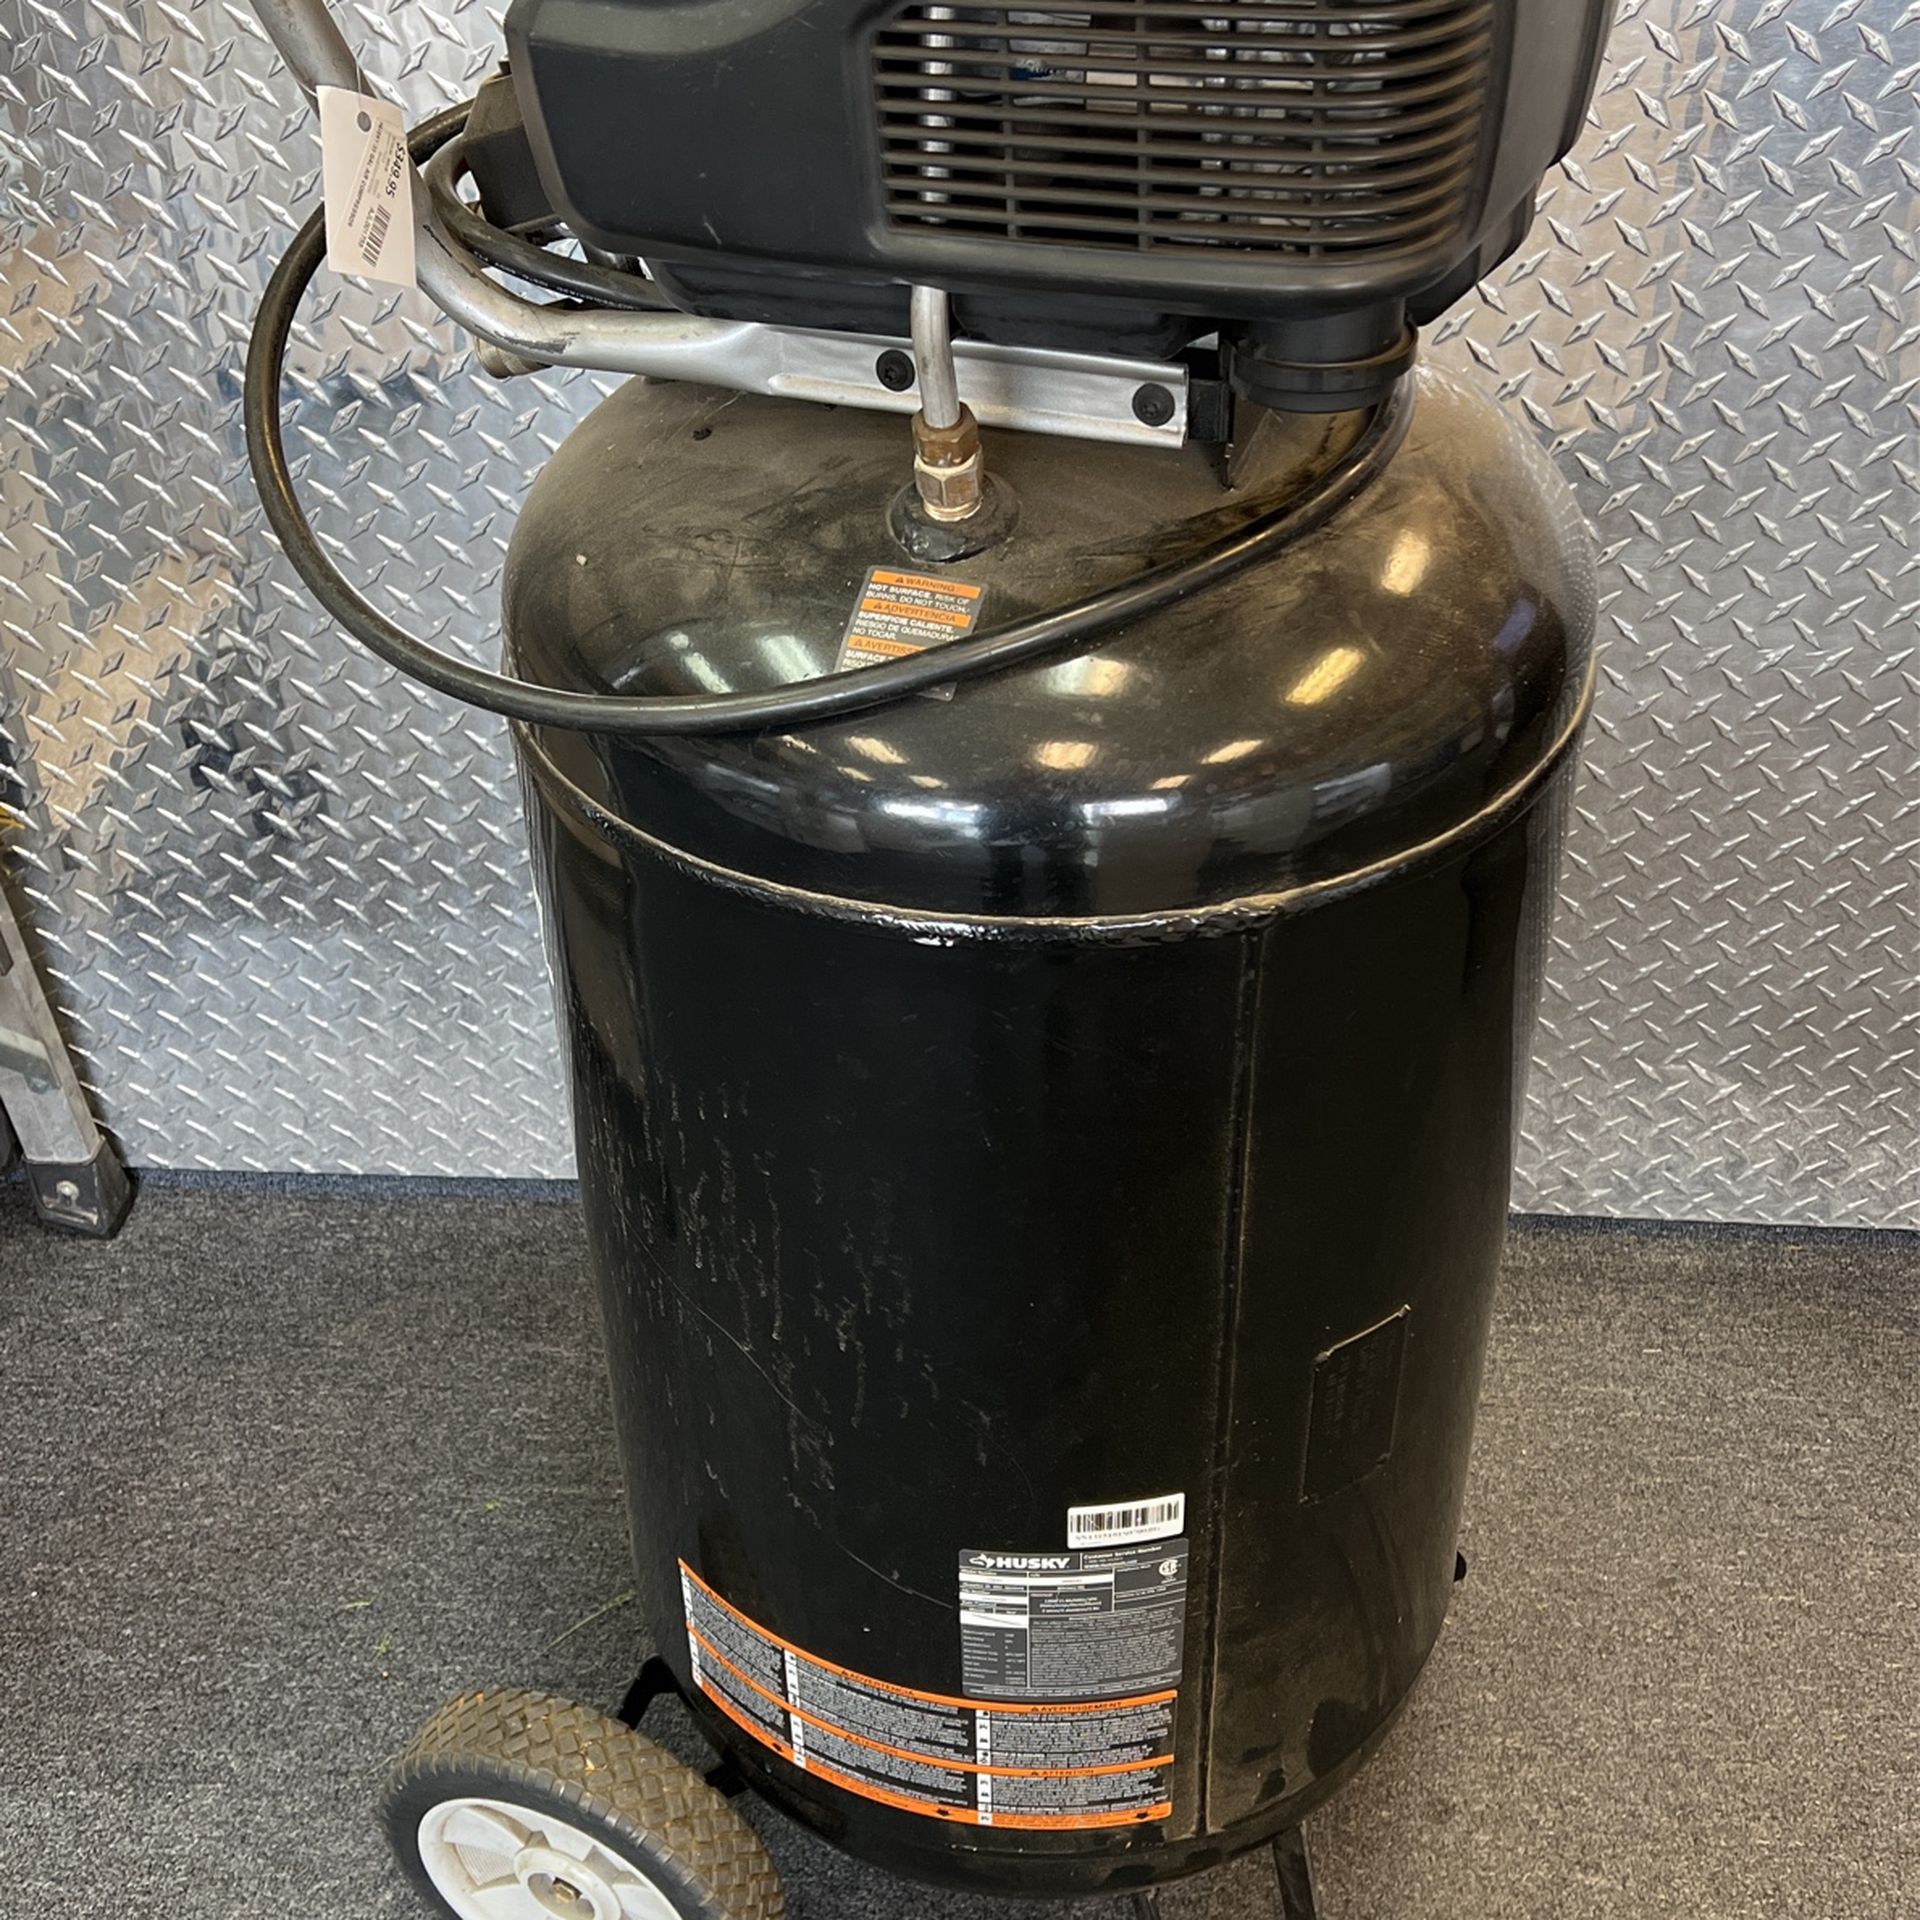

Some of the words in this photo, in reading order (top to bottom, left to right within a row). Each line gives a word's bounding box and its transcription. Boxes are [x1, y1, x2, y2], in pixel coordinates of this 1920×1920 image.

[385, 142, 406, 198] $349.95
[906, 576, 955, 592] WARNING
[866, 591, 897, 602] BURNS.
[899, 596, 913, 604] DO
[914, 598, 933, 606] NOT
[868, 583, 888, 592] HOT
[889, 585, 933, 598] SURFACE.
[935, 594, 956, 603] RISK
[858, 611, 908, 624] SUPERFICIE
[885, 603, 956, 622] ADVERTENCIA
[852, 627, 866, 635] NO
[855, 619, 886, 629] RIESGO
[996, 1556, 1071, 1570] HUSKY
